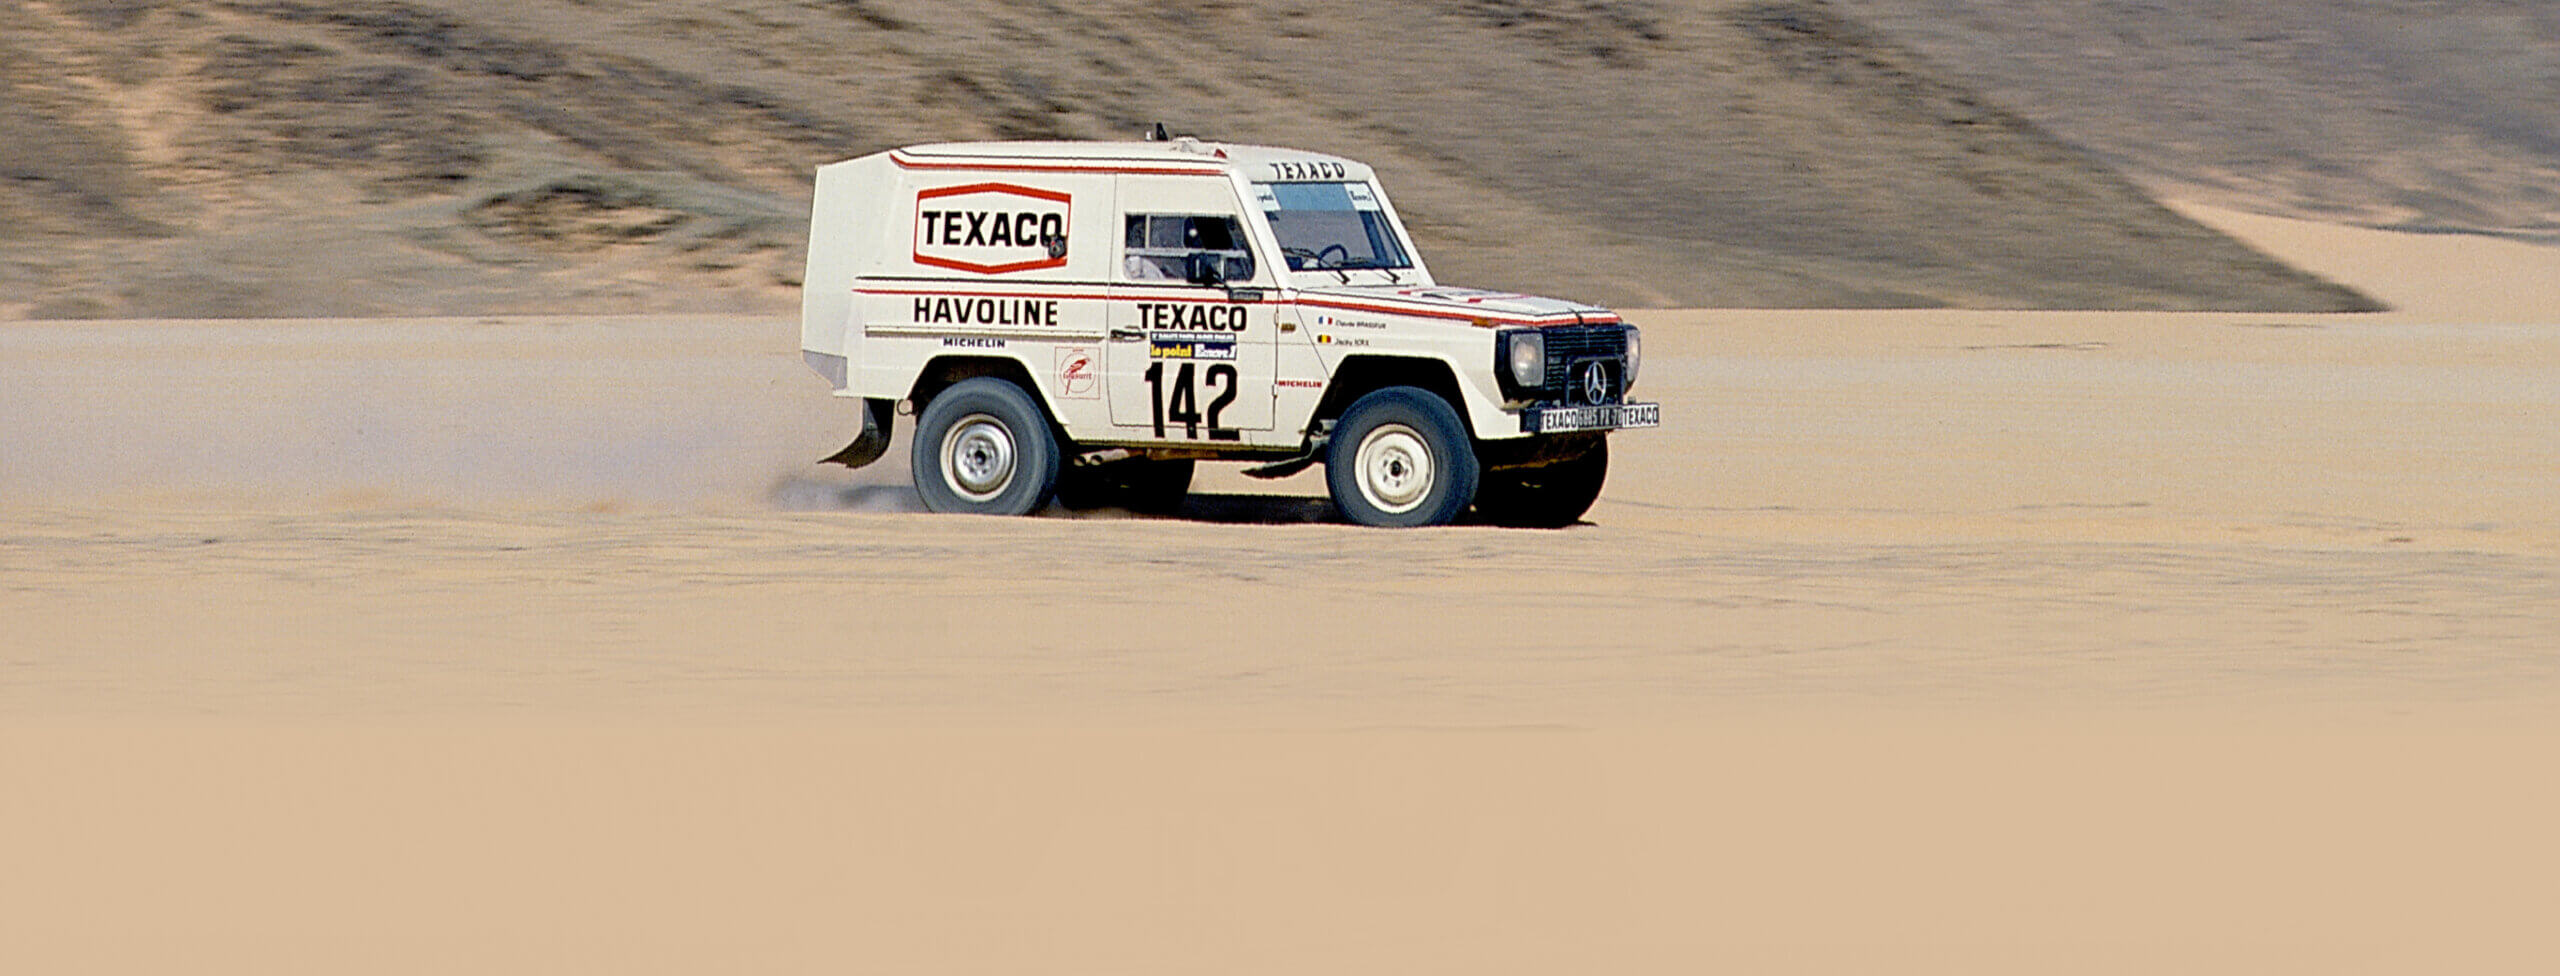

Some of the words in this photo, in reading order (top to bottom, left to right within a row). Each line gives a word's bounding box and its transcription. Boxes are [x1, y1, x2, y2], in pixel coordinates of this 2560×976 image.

[1268, 162, 1345, 179] TEXACO
[921, 210, 1063, 247] TEXACO
[914, 297, 1058, 326] HAVOLINE
[1137, 303, 1247, 331] TEXACO
[943, 337, 1006, 348] MICHELIN
[1278, 380, 1322, 388] MICHELIN
[1144, 361, 1240, 441] 142
[1541, 410, 1577, 430] TEXACO
[1622, 406, 1658, 425] TEXACO
